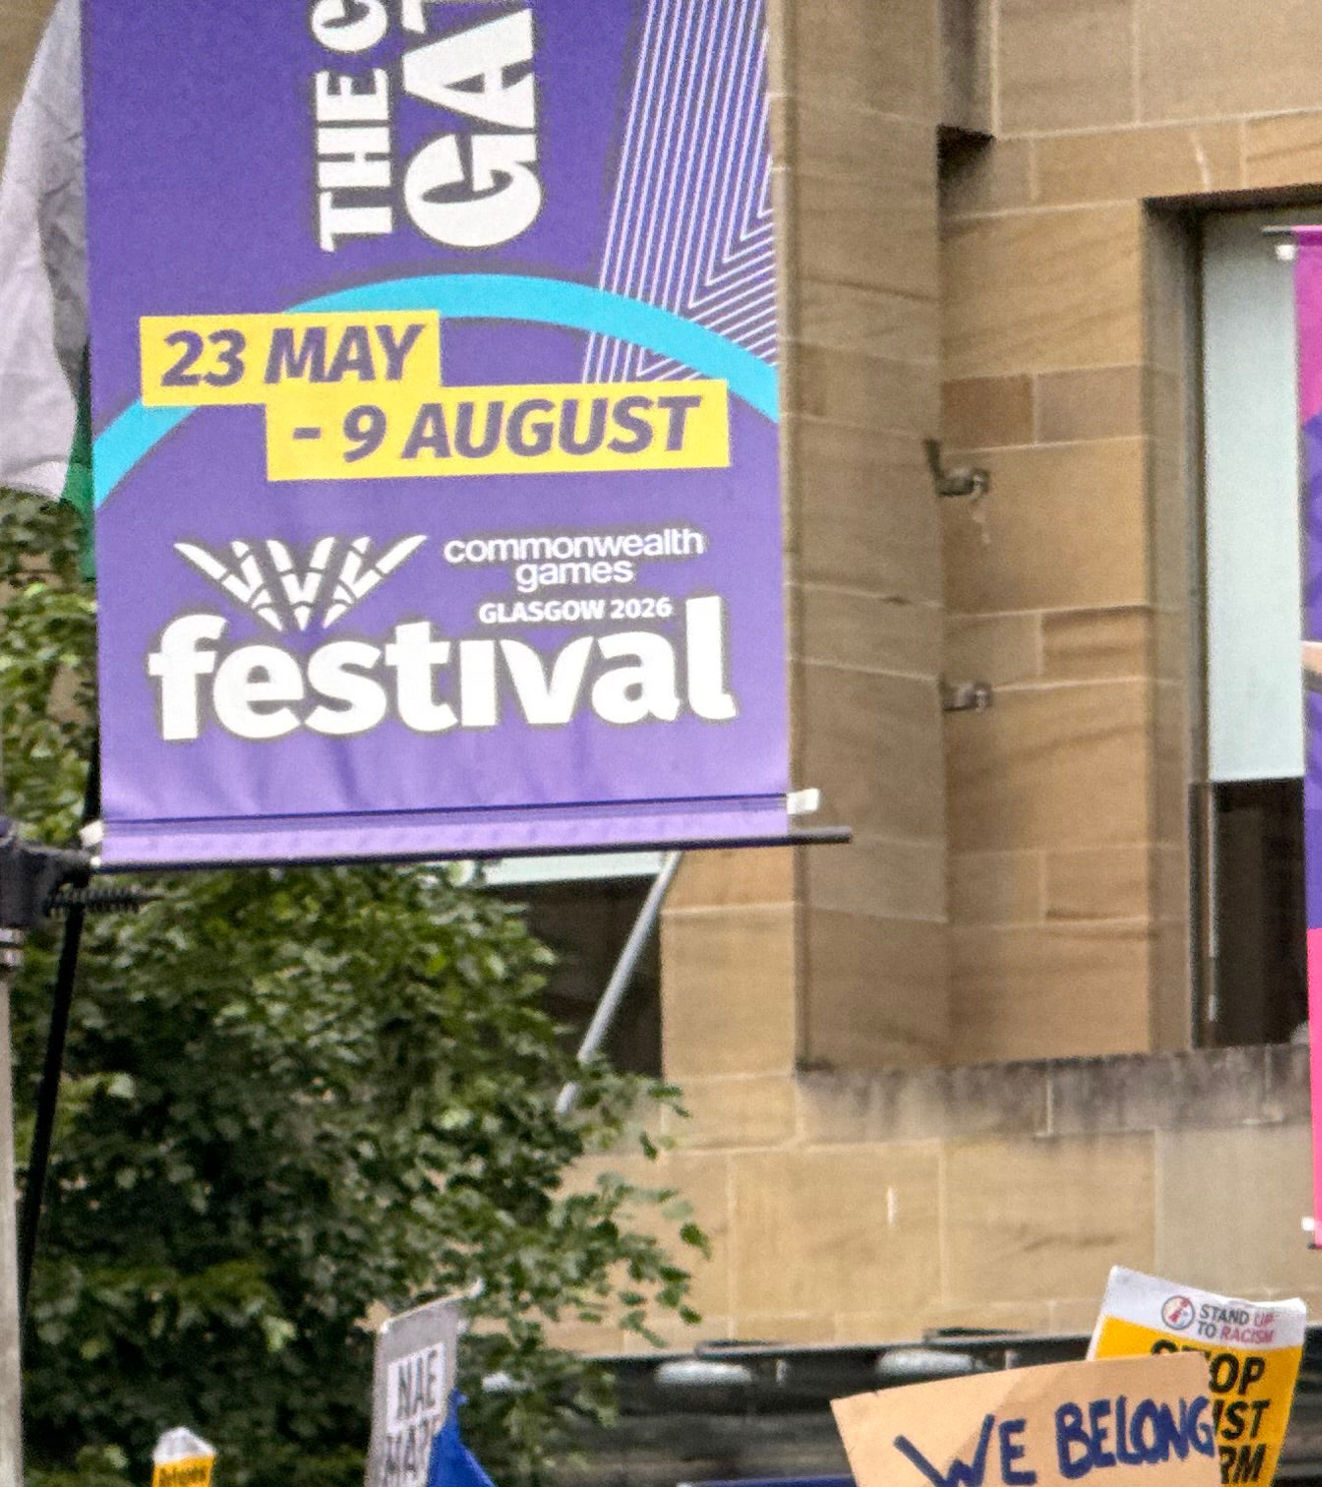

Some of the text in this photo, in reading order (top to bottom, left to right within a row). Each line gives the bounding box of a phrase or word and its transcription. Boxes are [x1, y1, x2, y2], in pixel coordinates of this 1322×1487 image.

[401, 0, 543, 249] GA
[314, 67, 394, 252] THE
[161, 321, 428, 388] 23 MAY
[342, 408, 388, 464] 9
[402, 394, 706, 462] AUGUST
[443, 528, 705, 564] commonwealth
[515, 558, 636, 591] games
[478, 596, 674, 625] GLASGOW 2026
[146, 594, 740, 743] festival
[1197, 1321, 1275, 1345] TO RACISM
[1199, 1303, 1250, 1326] STAND
[1055, 1394, 1219, 1481] BELONG
[1212, 1398, 1271, 1441] IST
